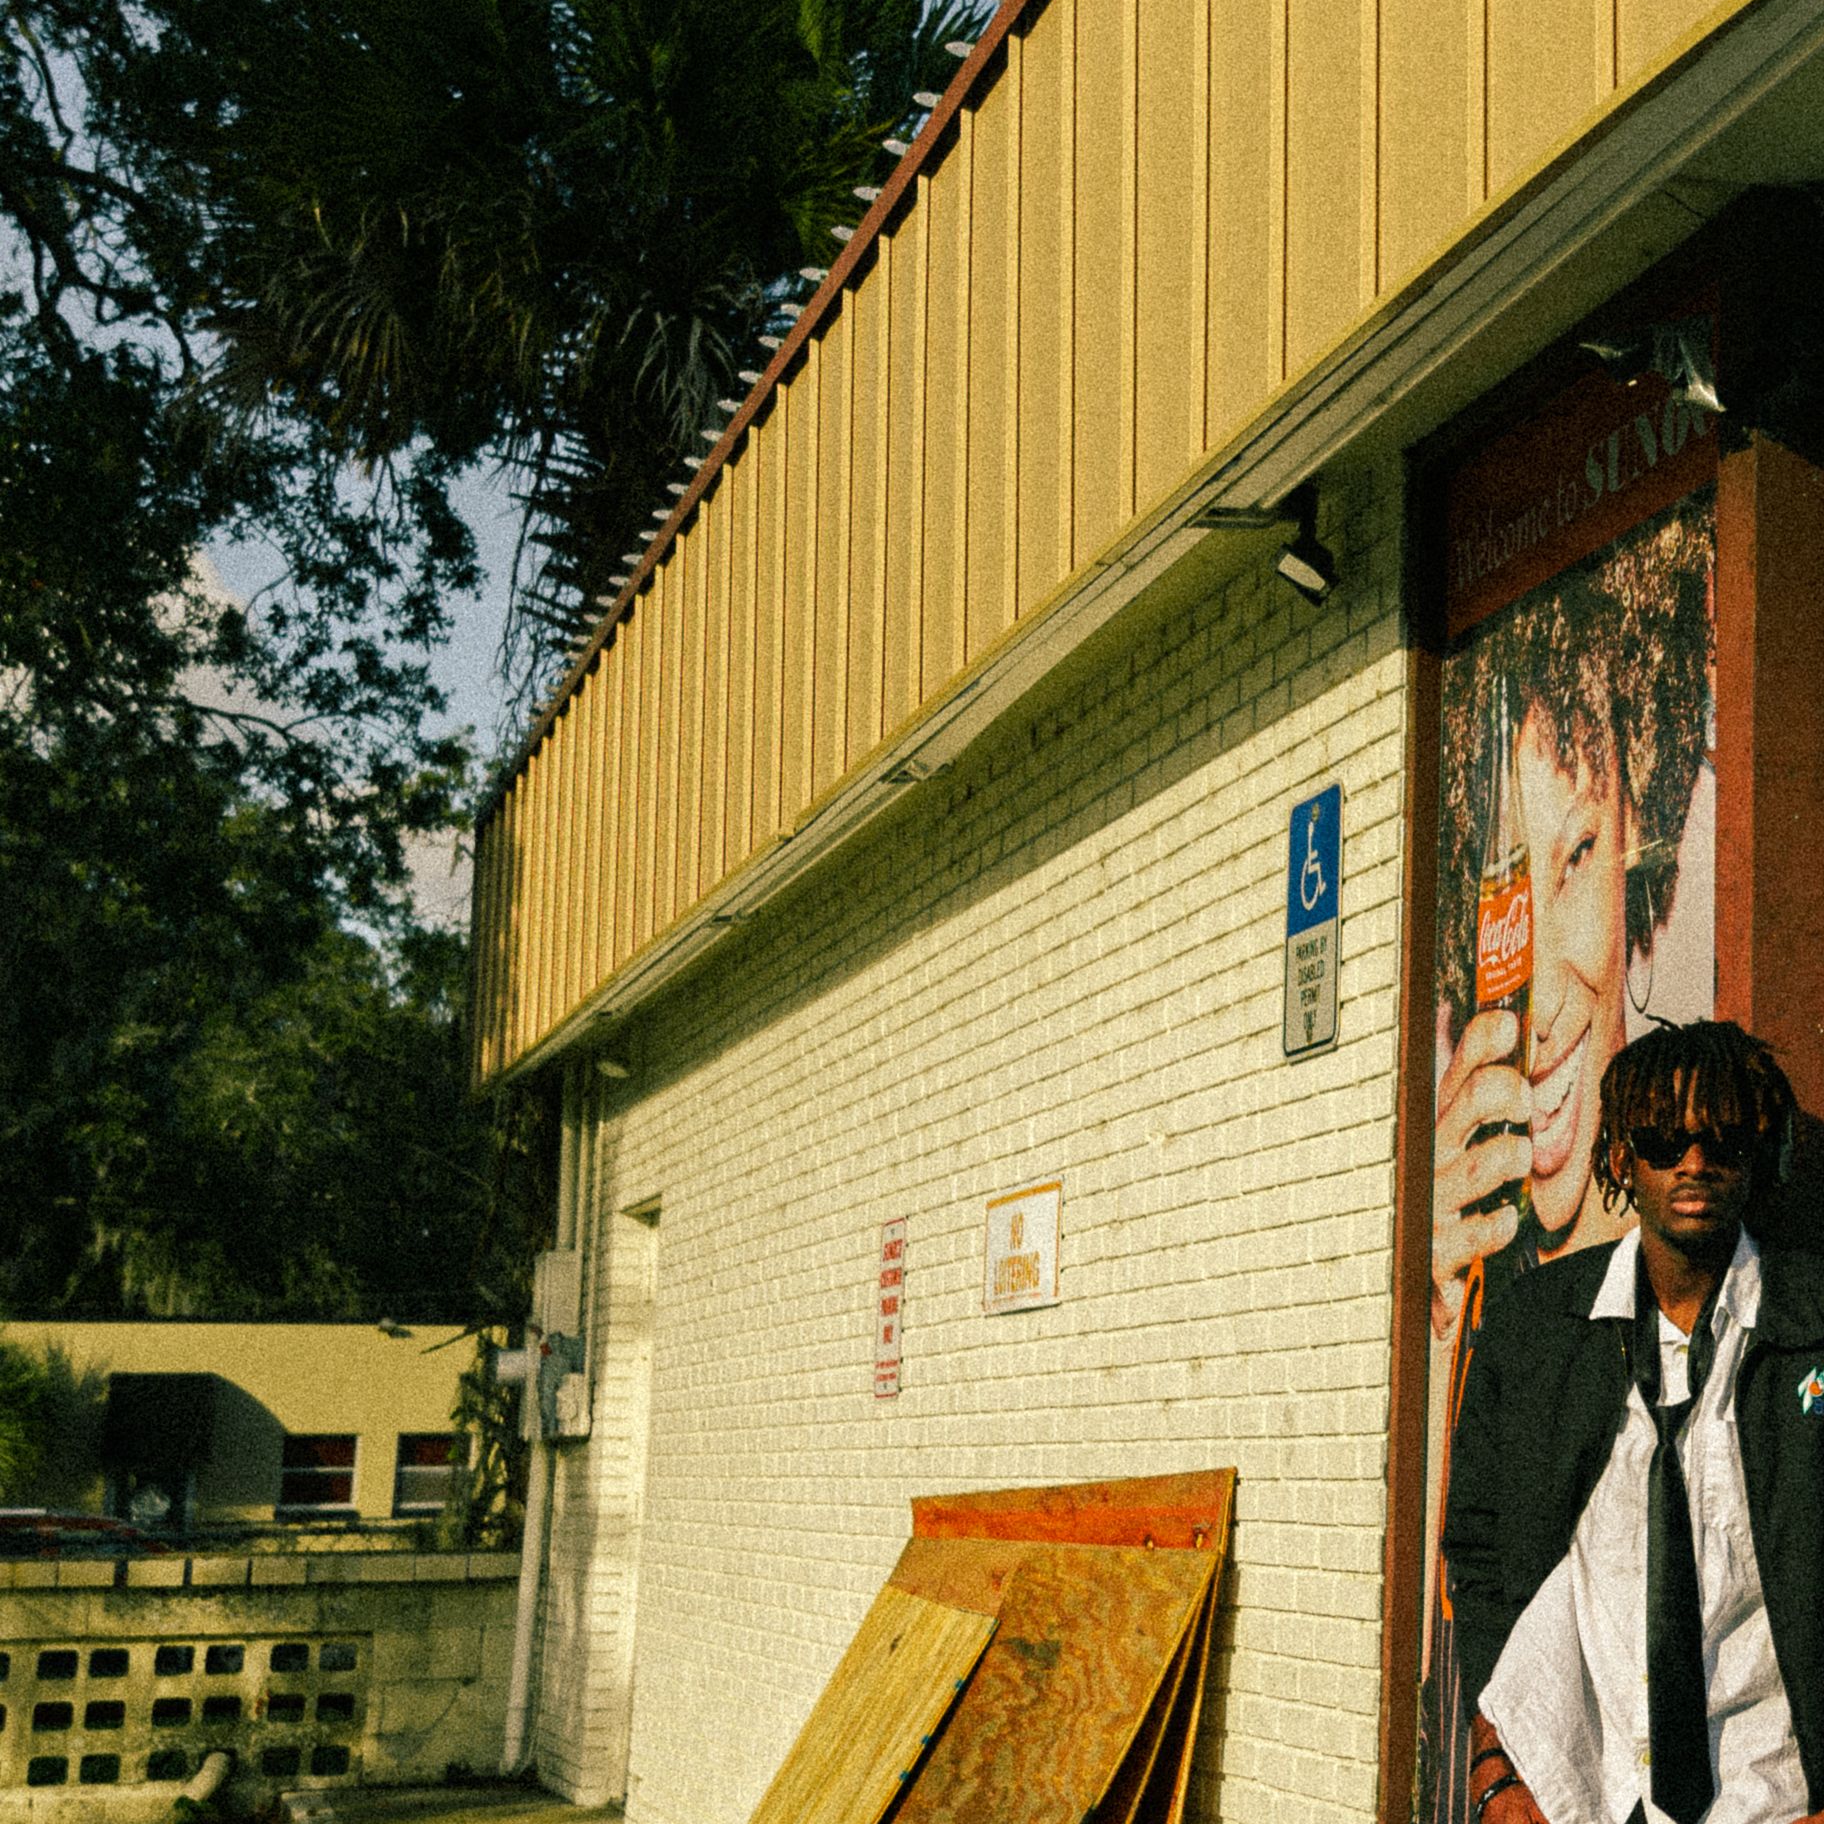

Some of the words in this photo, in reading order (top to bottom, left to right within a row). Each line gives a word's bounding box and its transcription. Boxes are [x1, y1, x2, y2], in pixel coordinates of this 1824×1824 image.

[1557, 473, 1578, 527] to
[1297, 960, 1325, 986] DISABLED
[1300, 984, 1321, 1008] PERMIT
[1009, 1212, 1024, 1251] NO
[994, 1250, 1041, 1296] LOITERING
